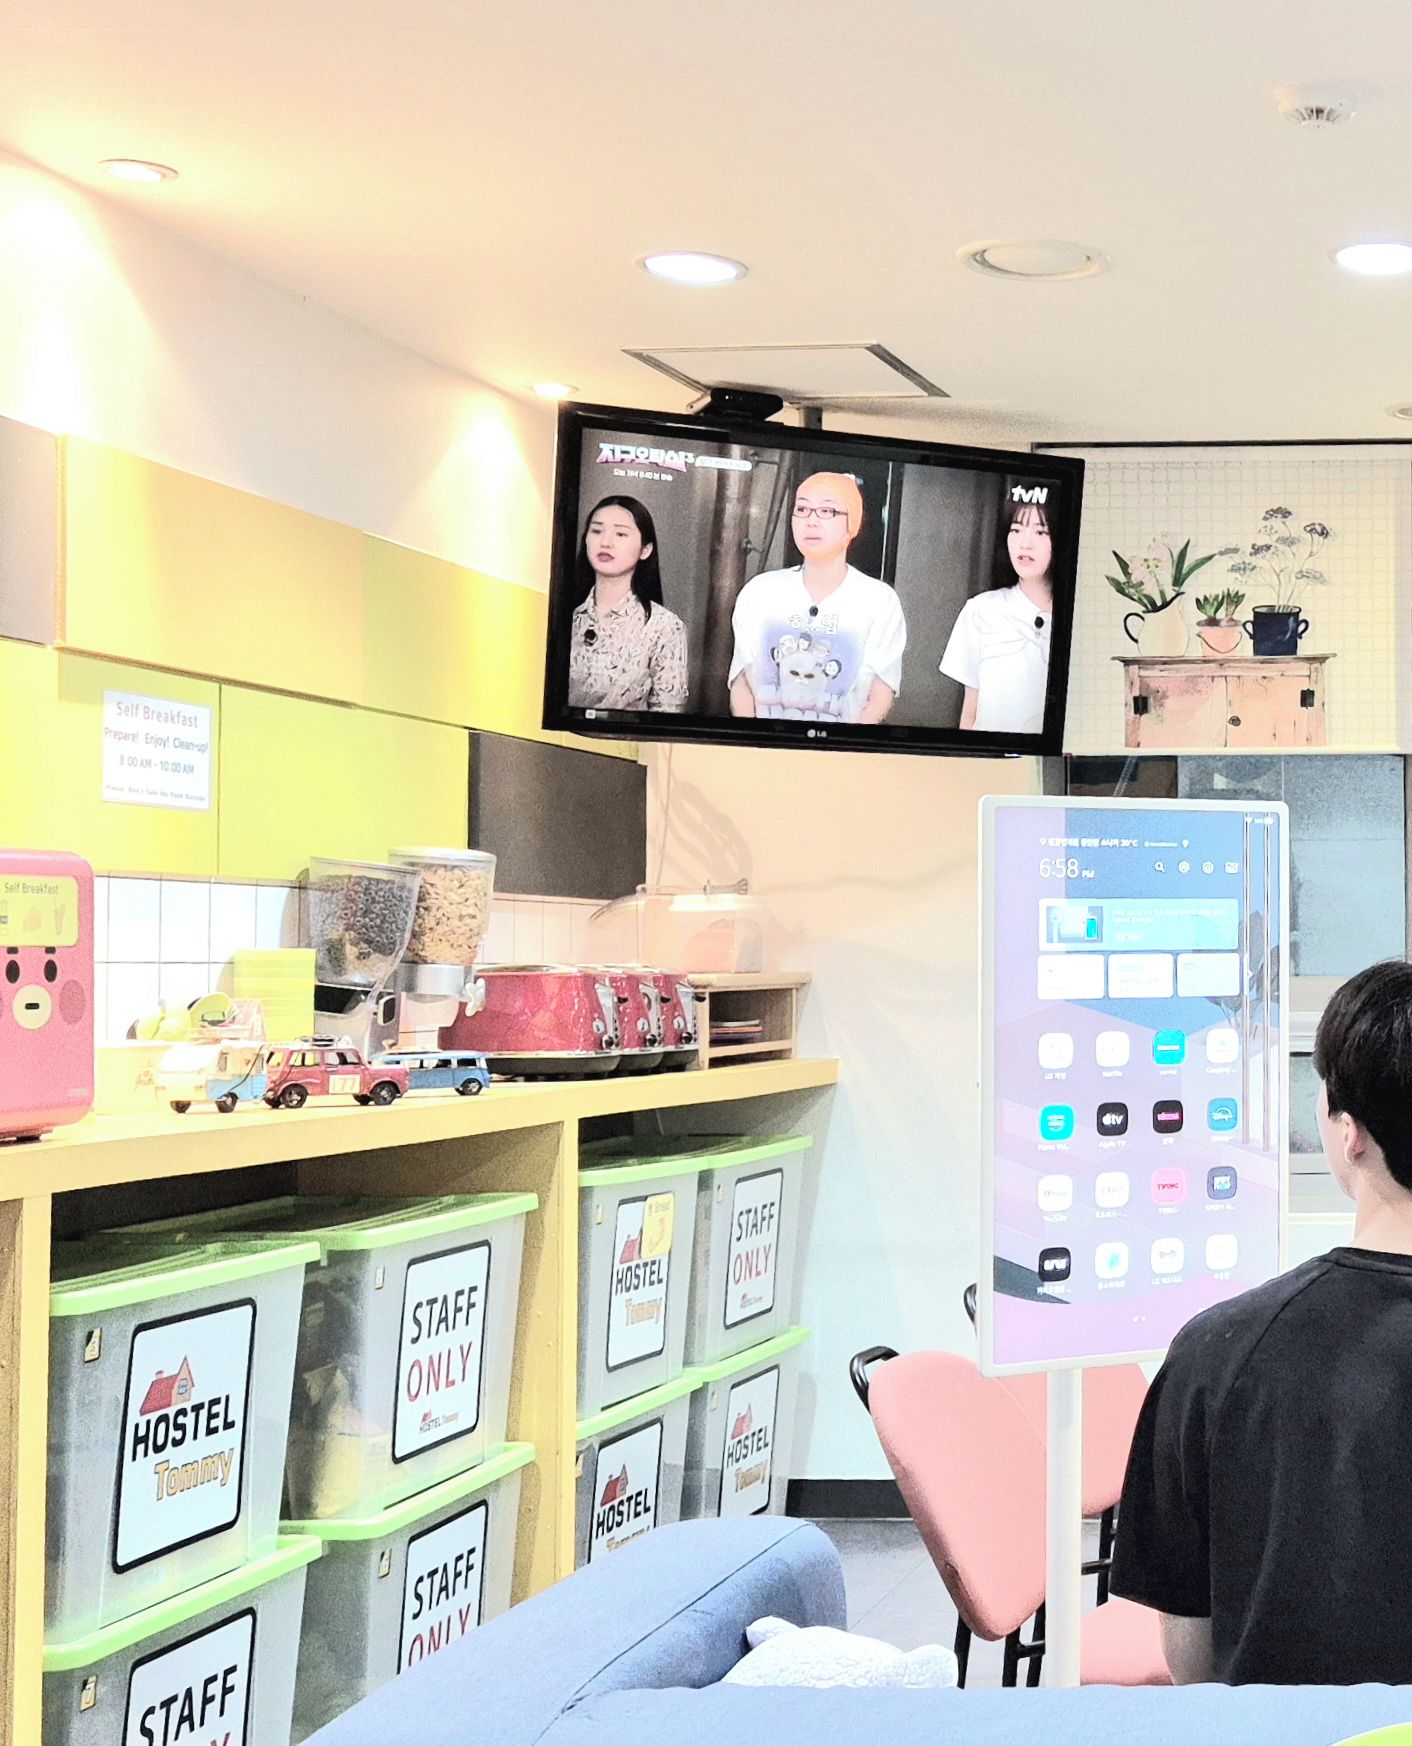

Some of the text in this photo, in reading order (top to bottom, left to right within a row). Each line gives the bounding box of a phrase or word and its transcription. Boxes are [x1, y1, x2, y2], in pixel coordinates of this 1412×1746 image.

[1011, 484, 1048, 504] tvN
[116, 701, 198, 728] Self Breakfast
[104, 726, 209, 754] Prepare! Enjoy! Clean-up!
[140, 758, 152, 769] AM
[160, 760, 180, 773] 10:00
[182, 764, 195, 775] AM
[1039, 858, 1095, 878] 6:58 PM
[4, 882, 59, 895] Self Breakfast
[736, 1202, 775, 1241] STAFF
[615, 1258, 663, 1295] HOSTEL
[733, 1243, 771, 1285] ONLY
[411, 1285, 478, 1345] STAFF
[625, 1298, 662, 1326] Tommy
[407, 1341, 473, 1403] ONLY
[131, 1393, 236, 1462] HOSTEL
[726, 1425, 769, 1468] HOSTEL
[154, 1447, 234, 1501] Tommy
[595, 1487, 652, 1540] HOSTEL
[411, 1546, 477, 1620] STAFF
[139, 1664, 238, 1746] STAFF
